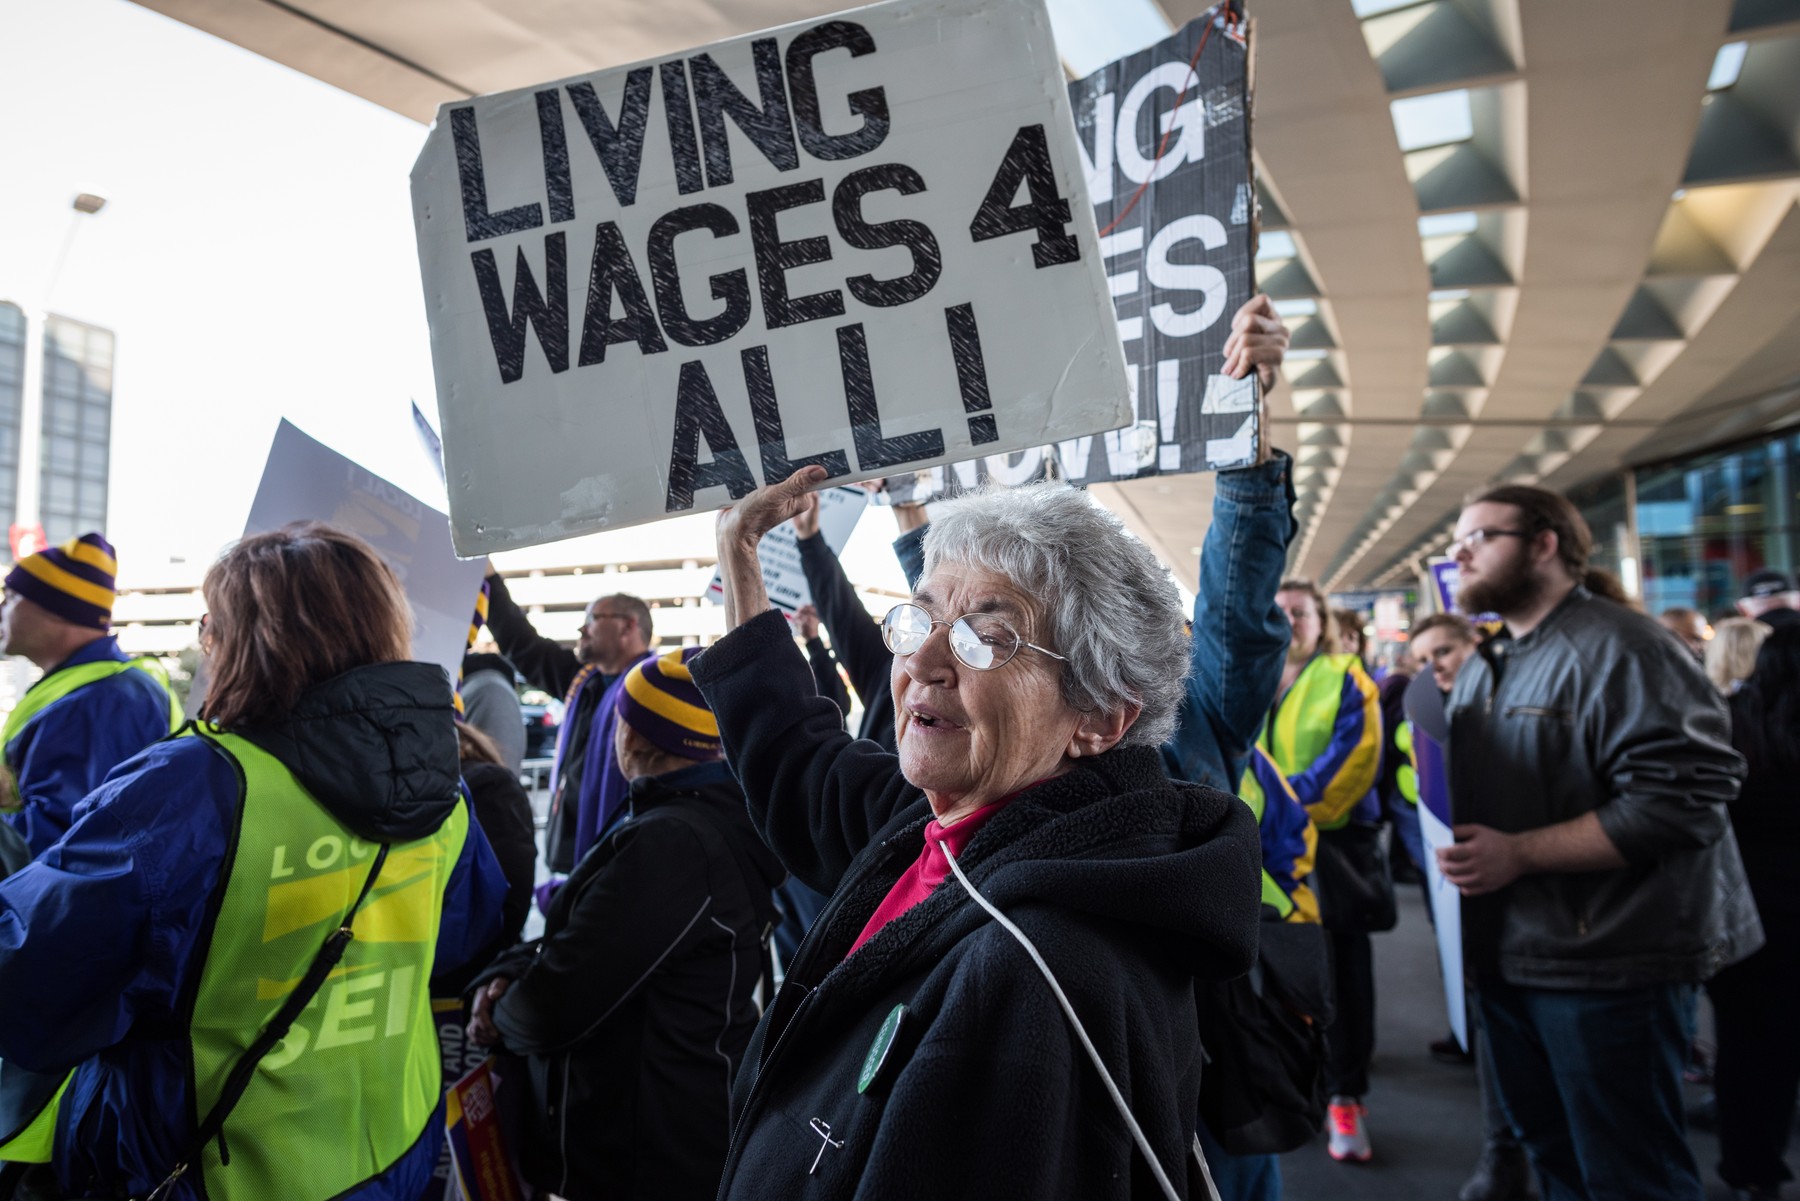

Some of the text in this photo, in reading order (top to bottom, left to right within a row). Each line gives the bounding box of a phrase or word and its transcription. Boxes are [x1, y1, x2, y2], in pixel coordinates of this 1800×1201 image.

[449, 20, 891, 243] LIVING
[472, 123, 1082, 384] WAGES 4
[666, 302, 999, 512] ALL!
[440, 1023, 464, 1074] AND
